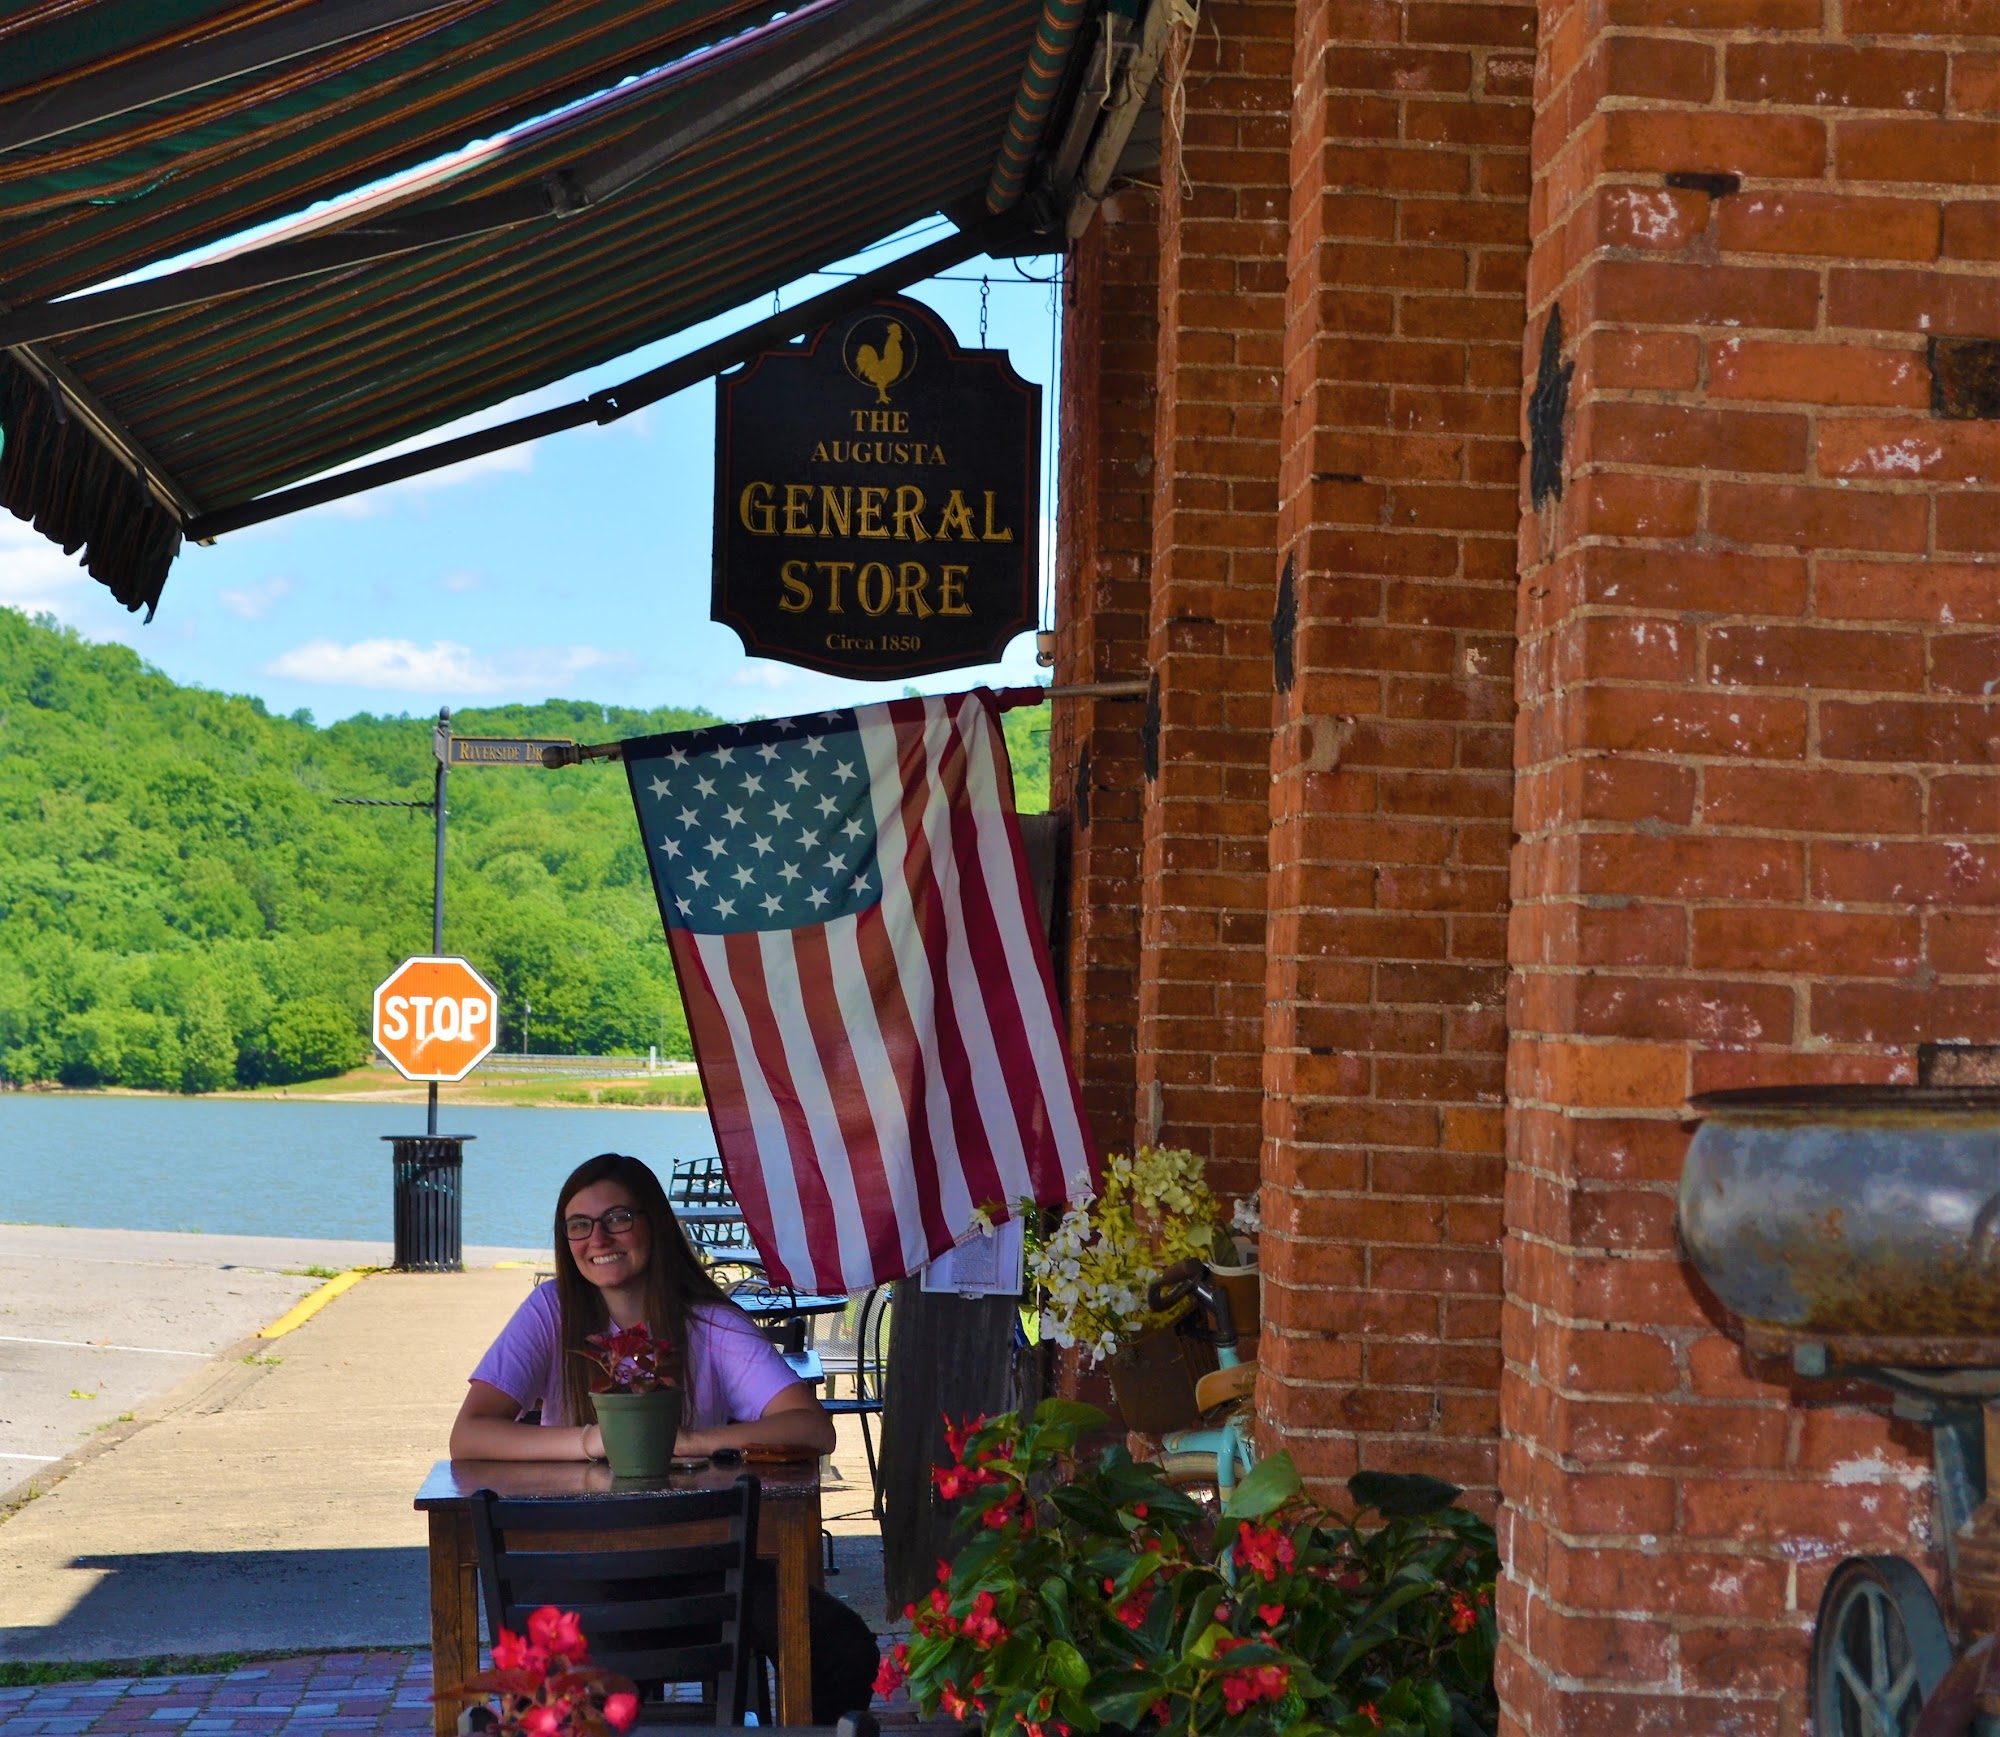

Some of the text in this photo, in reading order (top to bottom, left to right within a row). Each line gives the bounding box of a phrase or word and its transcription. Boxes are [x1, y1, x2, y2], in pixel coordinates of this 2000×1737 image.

[850, 410, 910, 433] THE
[809, 441, 948, 466] AUGUSTA
[739, 481, 1014, 543] GENERAL
[778, 559, 973, 620] STORE
[826, 632, 921, 653] Circa 1850
[383, 995, 488, 1042] STOP
